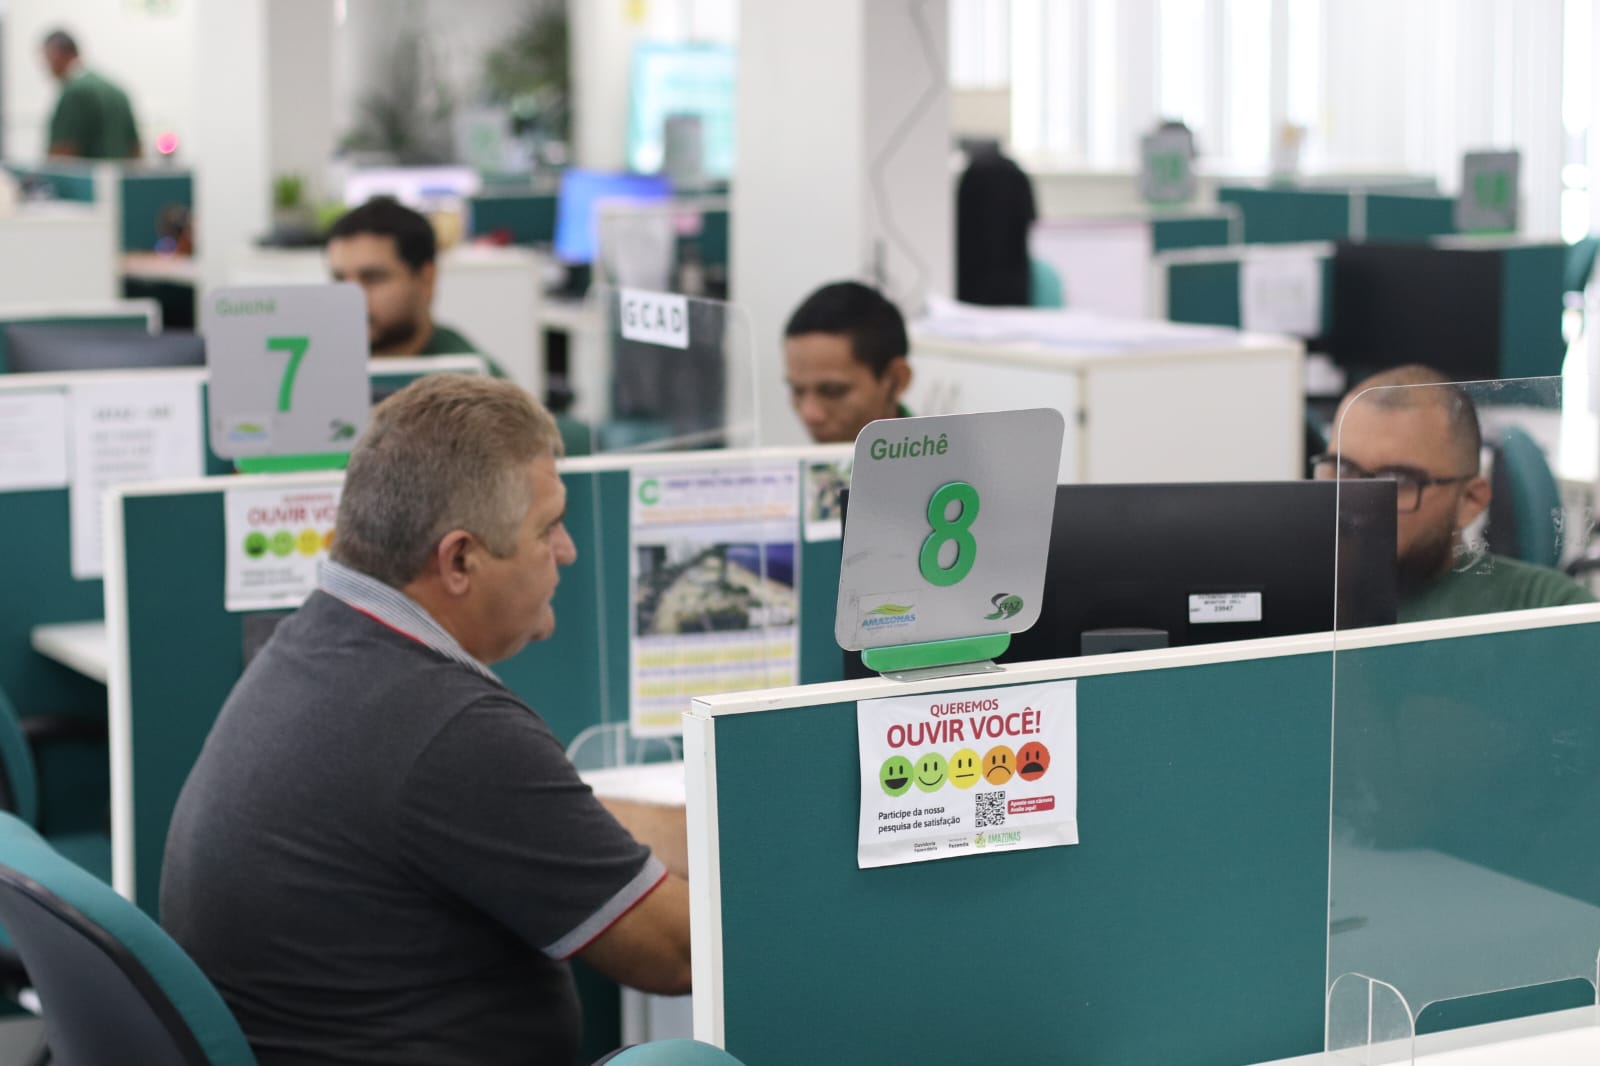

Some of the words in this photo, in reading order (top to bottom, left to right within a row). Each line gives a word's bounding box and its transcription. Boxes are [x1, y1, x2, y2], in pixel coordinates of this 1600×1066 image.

[623, 299, 685, 334] GCAD
[266, 335, 311, 414] 7
[869, 433, 949, 461] Guichê
[918, 481, 980, 587] 8
[930, 698, 999, 717] QUEREMOS
[886, 718, 965, 748] OUVIR
[969, 706, 1041, 740] VOCÊ!
[878, 809, 911, 820] Participe
[912, 808, 922, 816] da
[924, 806, 944, 815] nossa
[878, 822, 911, 834] pesquisa
[912, 820, 922, 828] de
[924, 816, 961, 827] satisfação
[988, 831, 1022, 844] AMAZONAS
